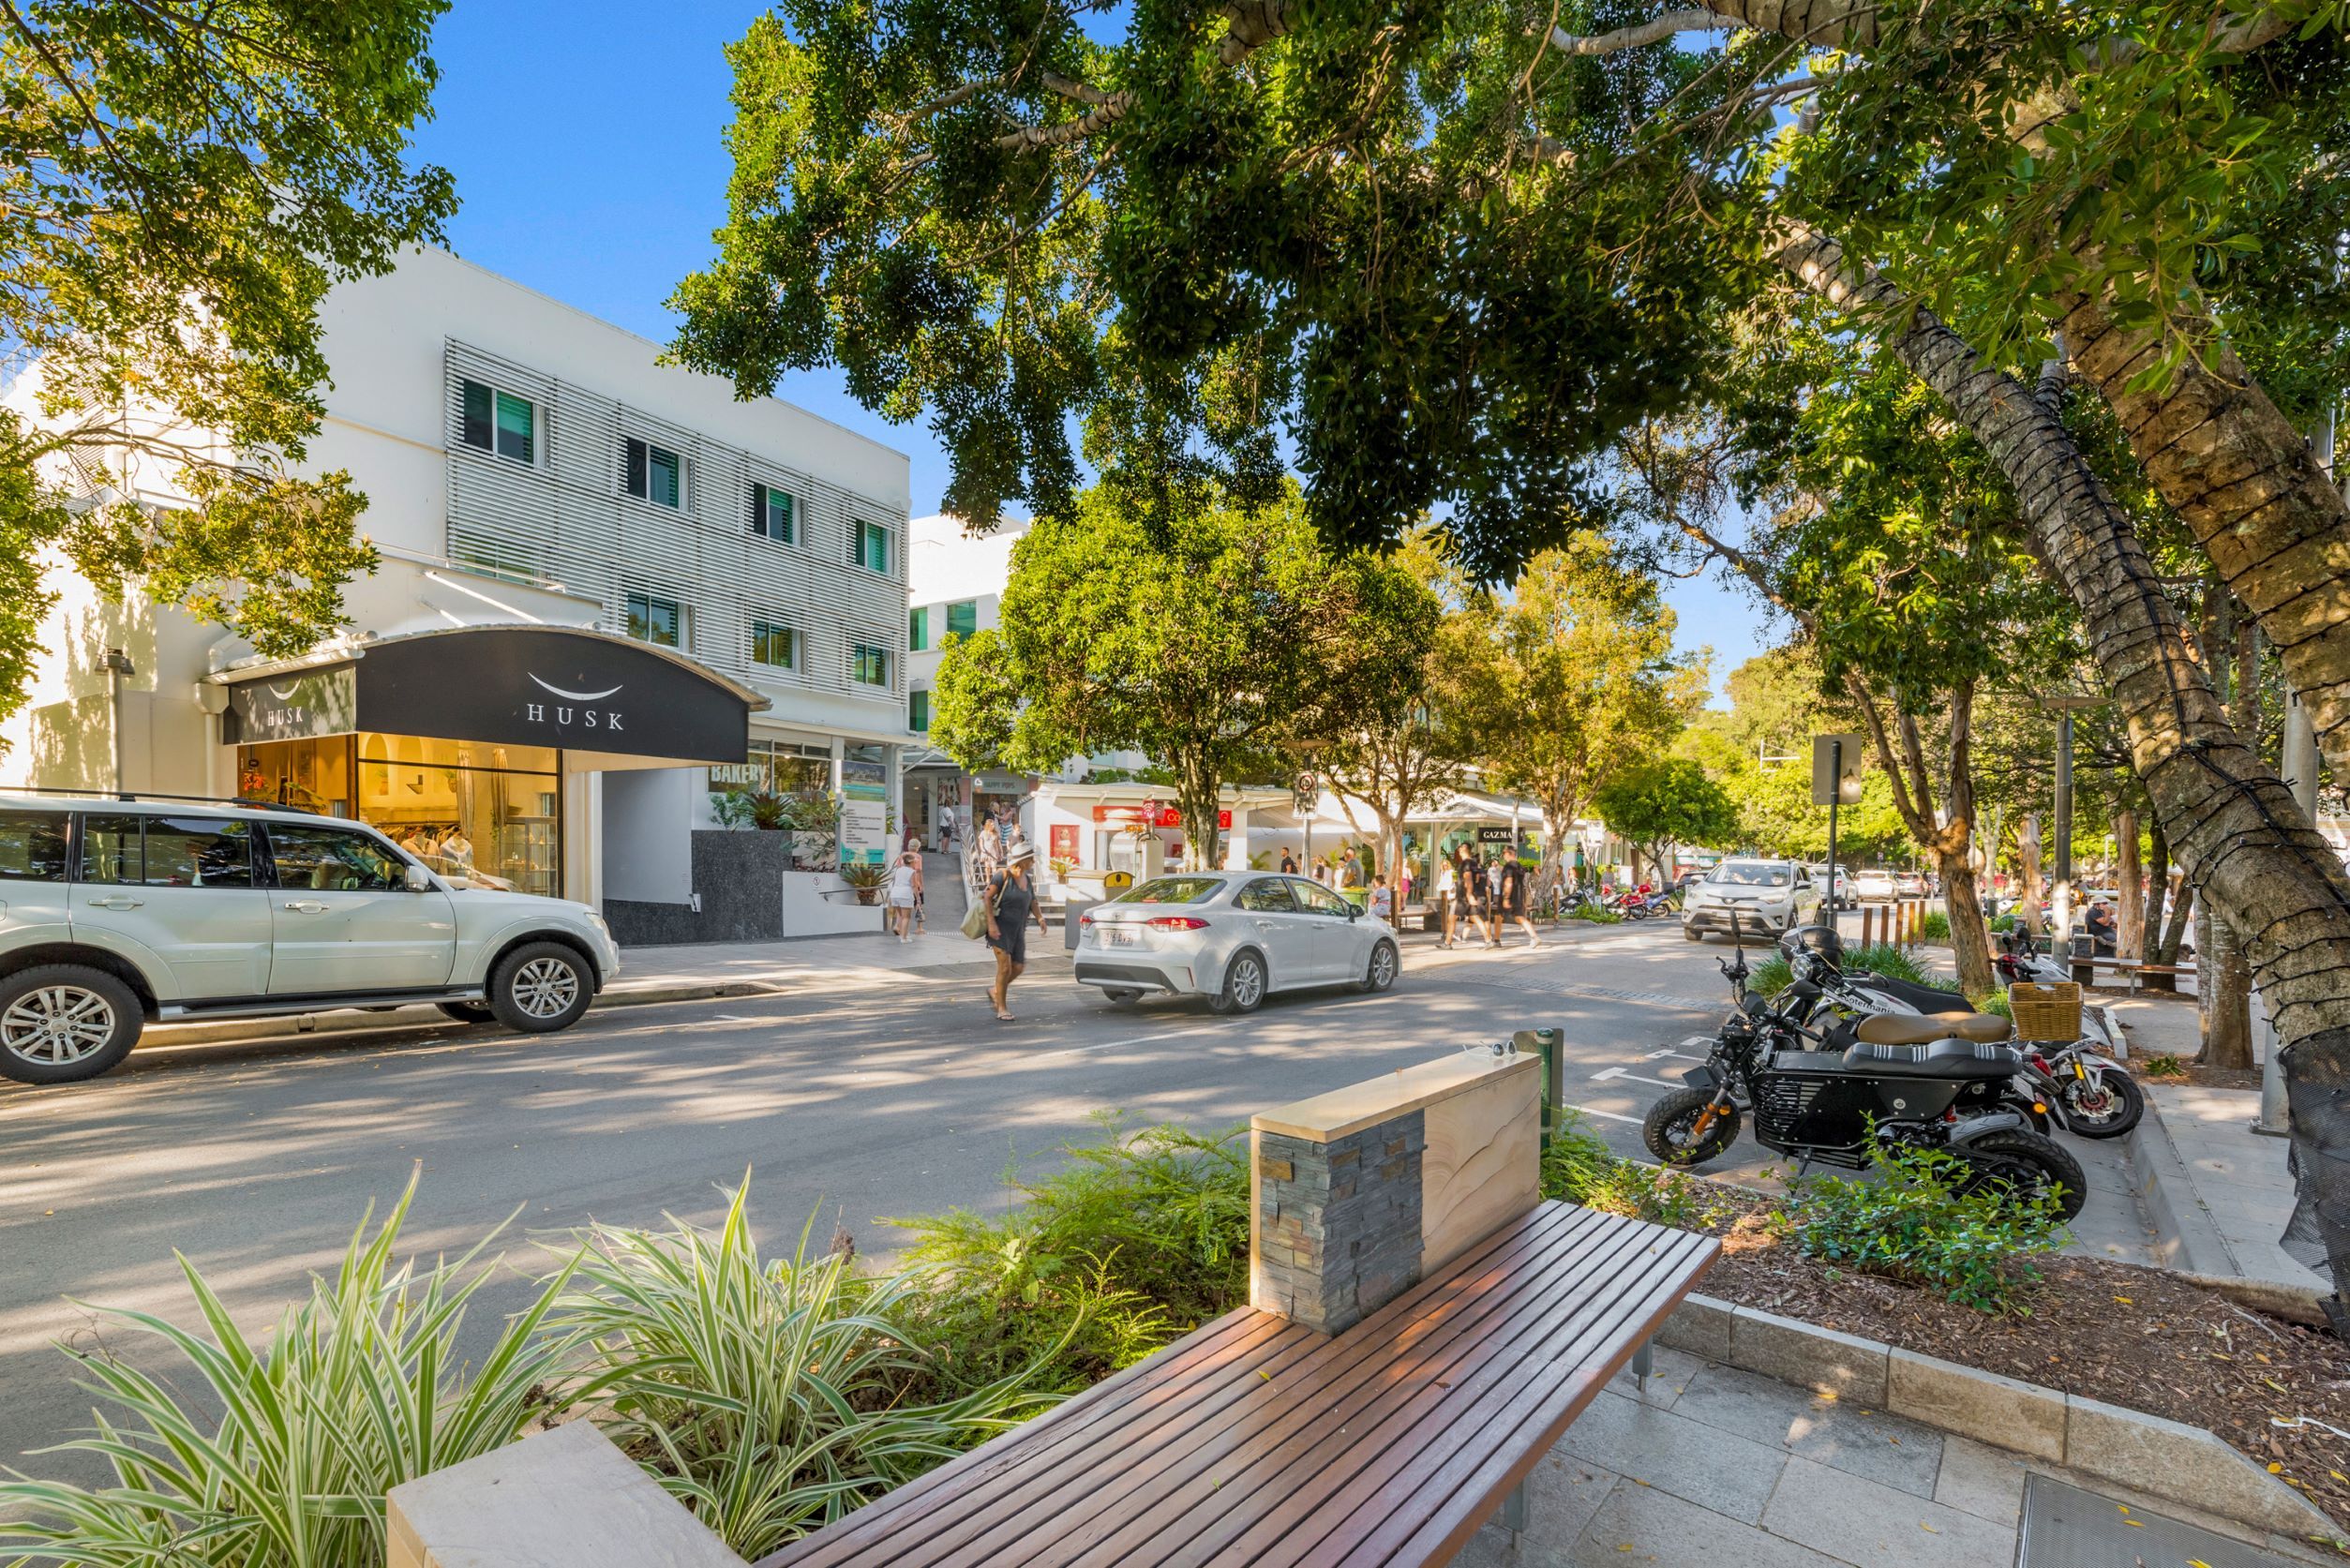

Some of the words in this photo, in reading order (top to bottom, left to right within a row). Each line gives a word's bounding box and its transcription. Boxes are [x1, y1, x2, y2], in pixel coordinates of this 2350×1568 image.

[267, 706, 303, 727] HUSK
[526, 703, 624, 730] HUSK
[711, 763, 768, 784] BAKERY
[1483, 830, 1513, 839] GAZMA
